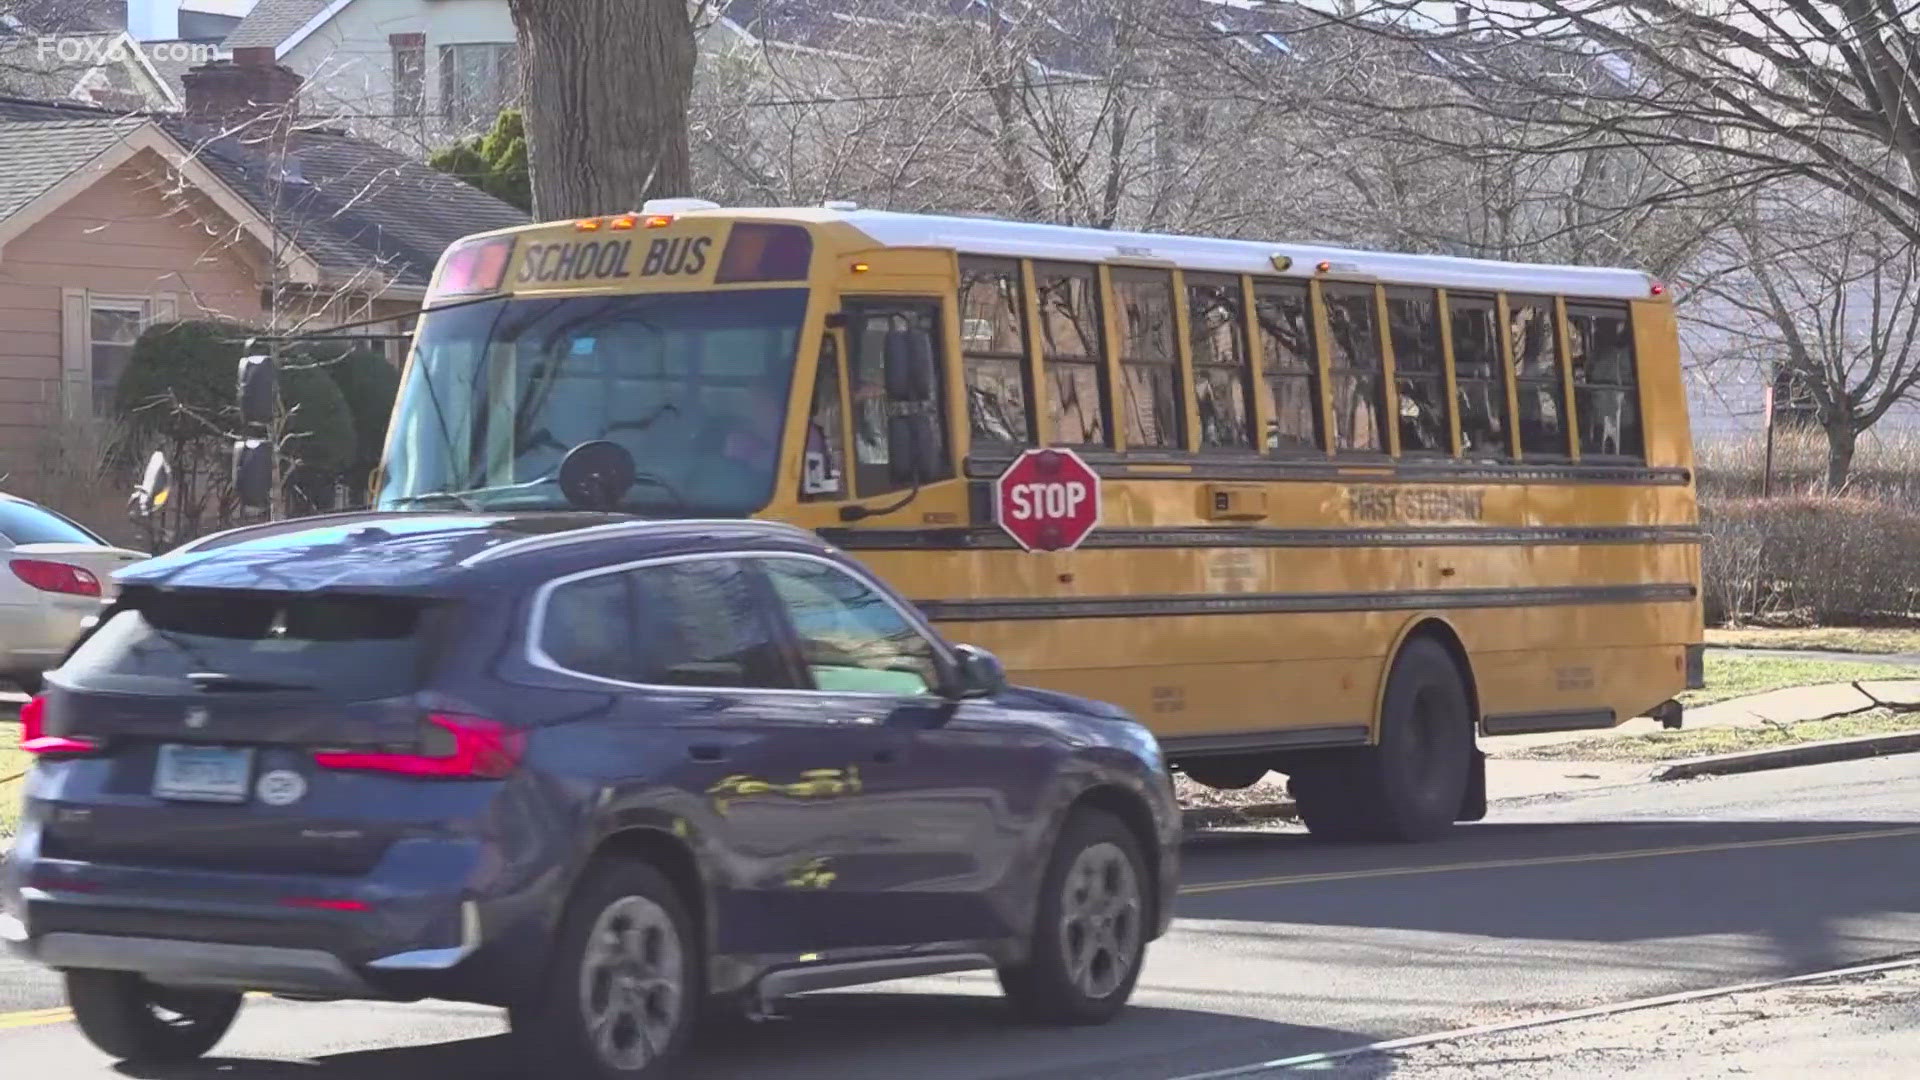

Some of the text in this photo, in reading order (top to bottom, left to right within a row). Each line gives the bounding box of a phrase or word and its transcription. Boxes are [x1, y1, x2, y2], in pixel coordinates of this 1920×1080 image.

[518, 235, 712, 283] SCHOOL BUS
[1010, 481, 1086, 520] STOP
[1349, 488, 1399, 521] FIRST
